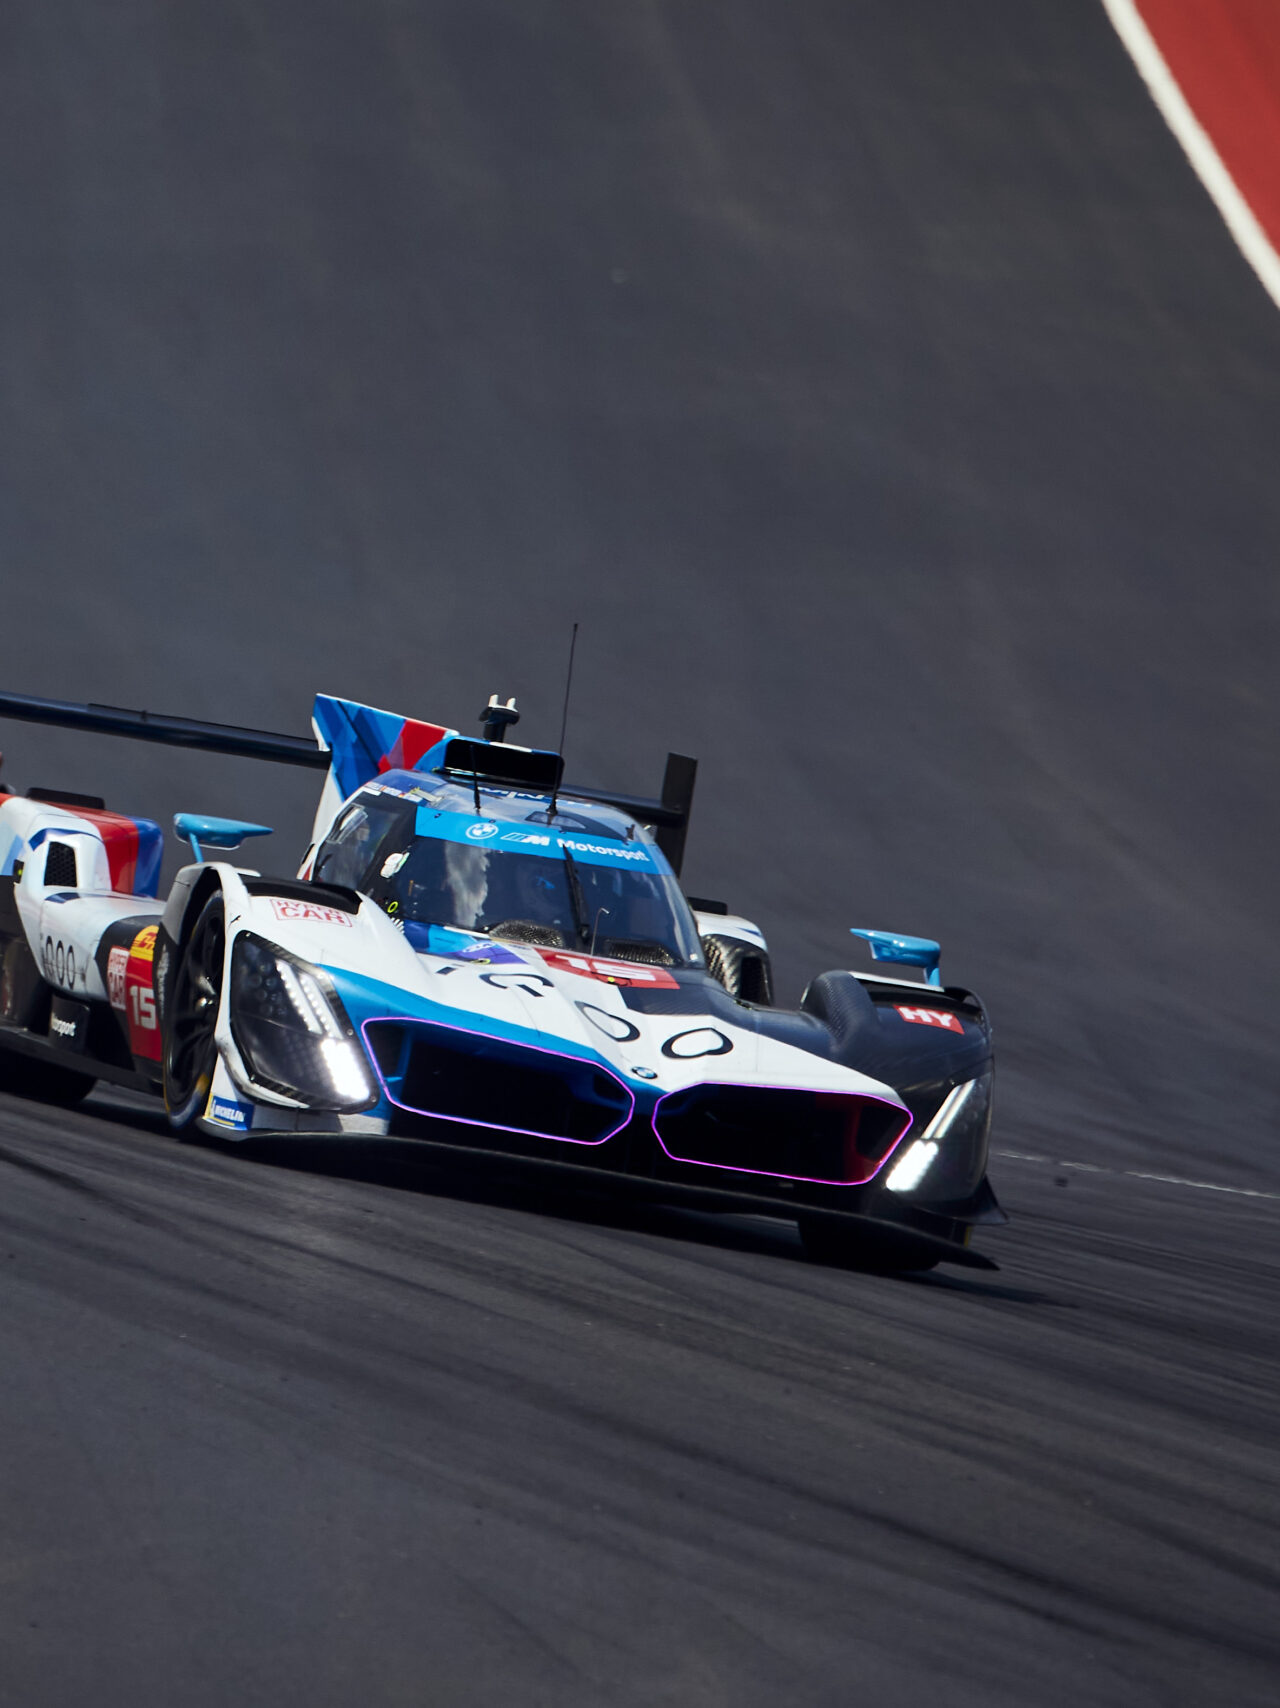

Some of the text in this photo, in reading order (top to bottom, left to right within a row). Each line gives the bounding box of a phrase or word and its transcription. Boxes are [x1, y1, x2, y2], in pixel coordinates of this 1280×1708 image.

[556, 838, 650, 861] Motorsport
[280, 906, 345, 924] CAR
[555, 954, 657, 981] 15
[130, 986, 156, 1029] 15
[899, 1007, 952, 1027] HY
[214, 1104, 245, 1122] MICHELIN
